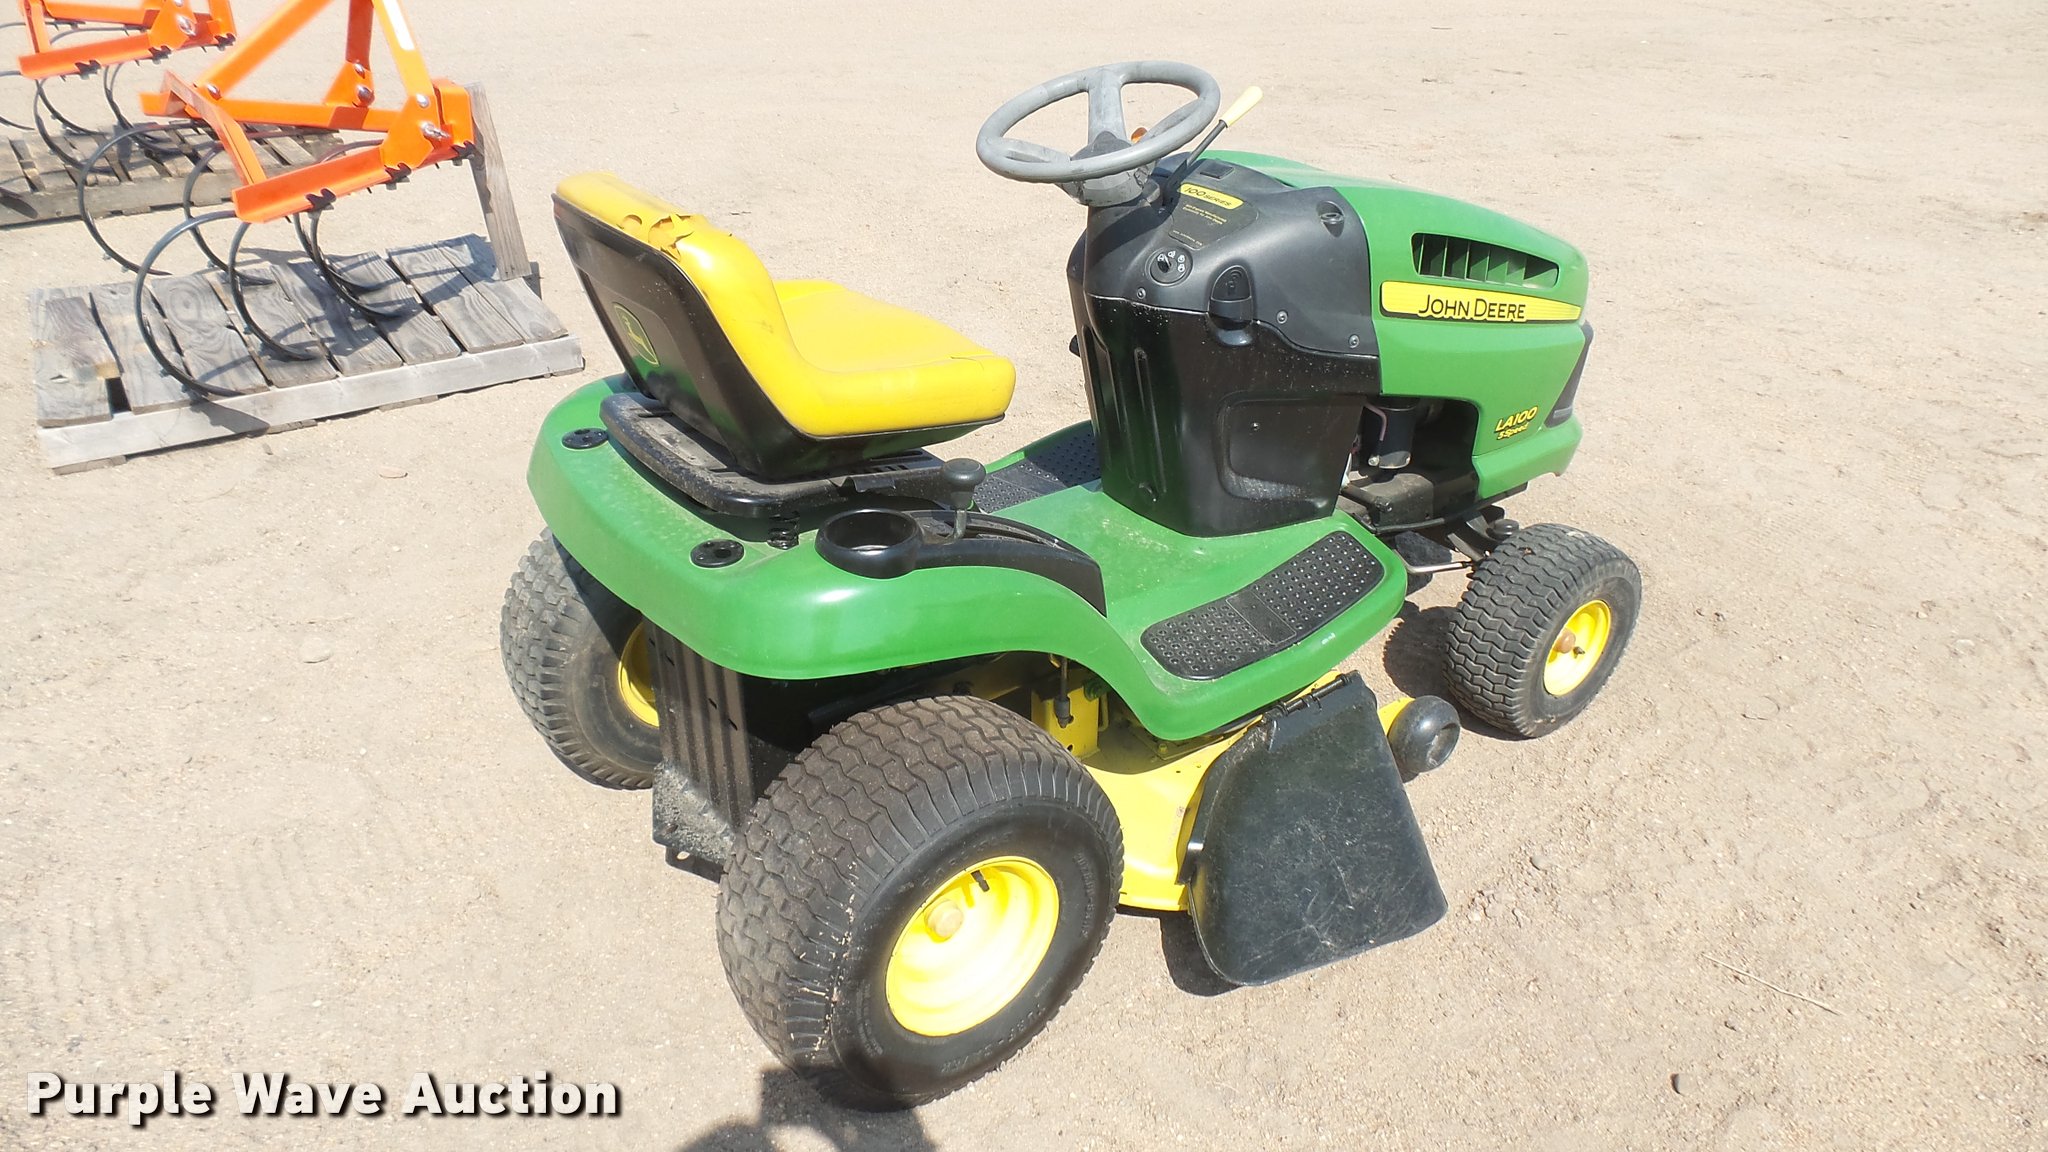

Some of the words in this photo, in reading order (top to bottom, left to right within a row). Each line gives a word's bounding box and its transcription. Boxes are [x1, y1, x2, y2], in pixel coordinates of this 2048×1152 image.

[1418, 294, 1470, 316] JOHN
[1474, 298, 1526, 319] DEERE
[1495, 406, 1538, 432] LA100
